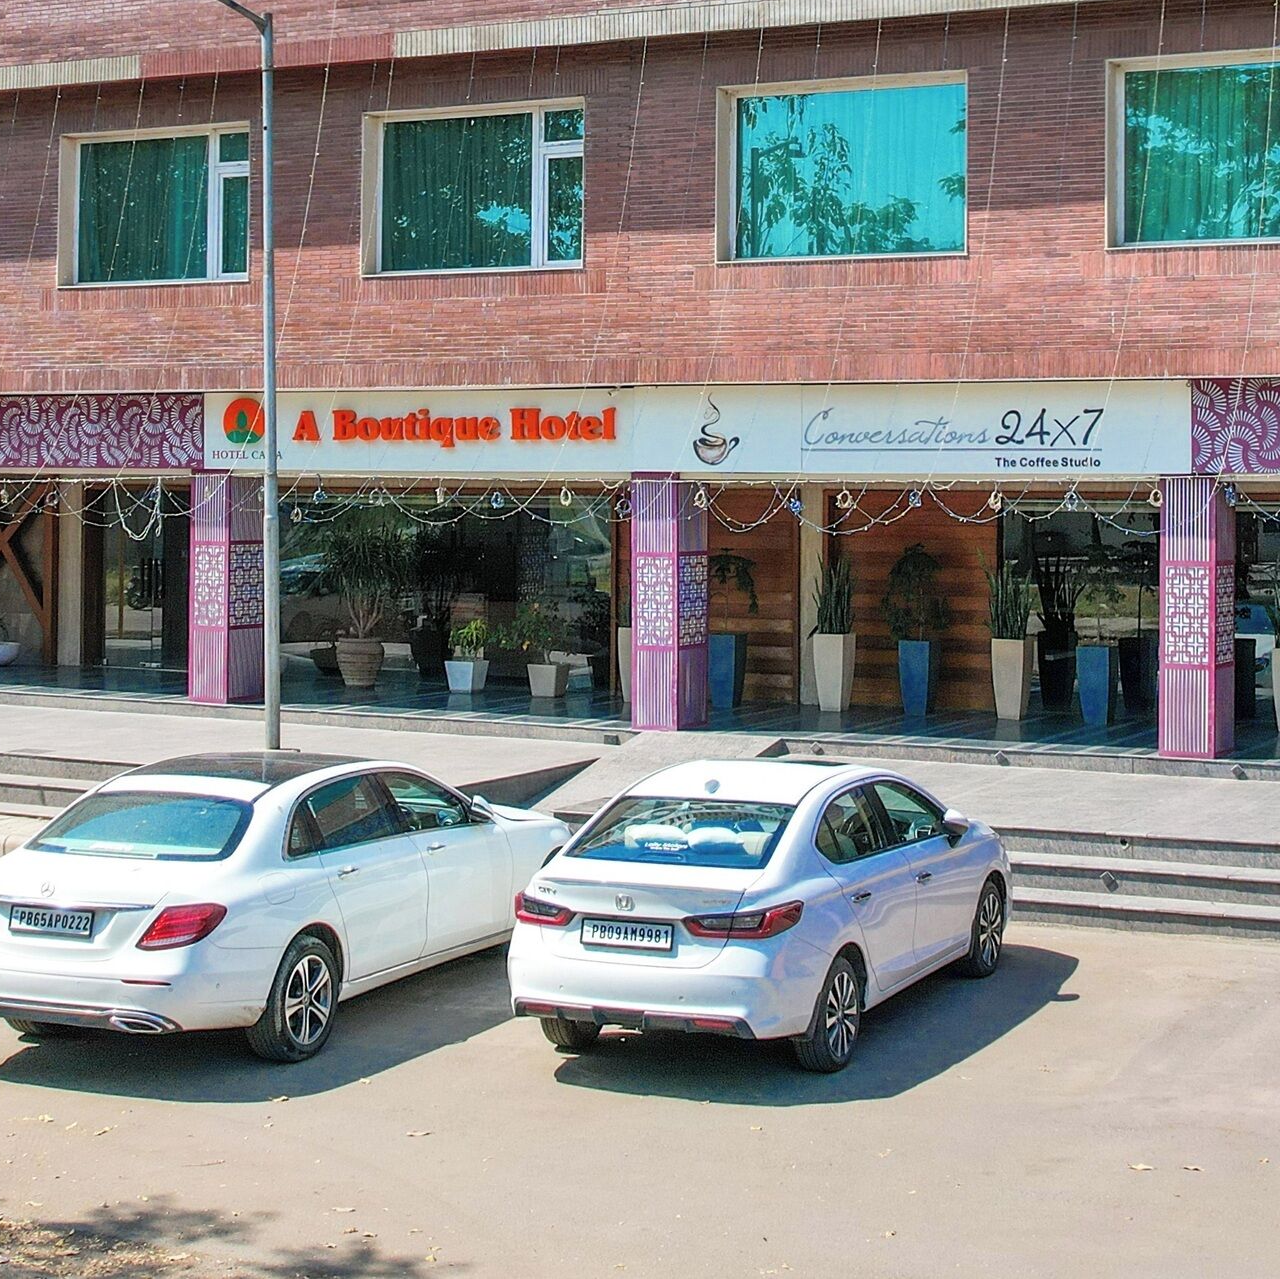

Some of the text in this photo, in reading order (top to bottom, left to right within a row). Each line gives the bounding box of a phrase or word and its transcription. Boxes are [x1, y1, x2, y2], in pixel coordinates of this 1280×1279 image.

[292, 407, 617, 448] A Boutique Hotel
[803, 406, 993, 445] Conversations
[212, 450, 283, 460] HOTEL CAA
[995, 457, 1101, 468] The Coffee Studio
[19, 912, 91, 932] PB65AP0222
[592, 924, 670, 945] PB09AM9981
